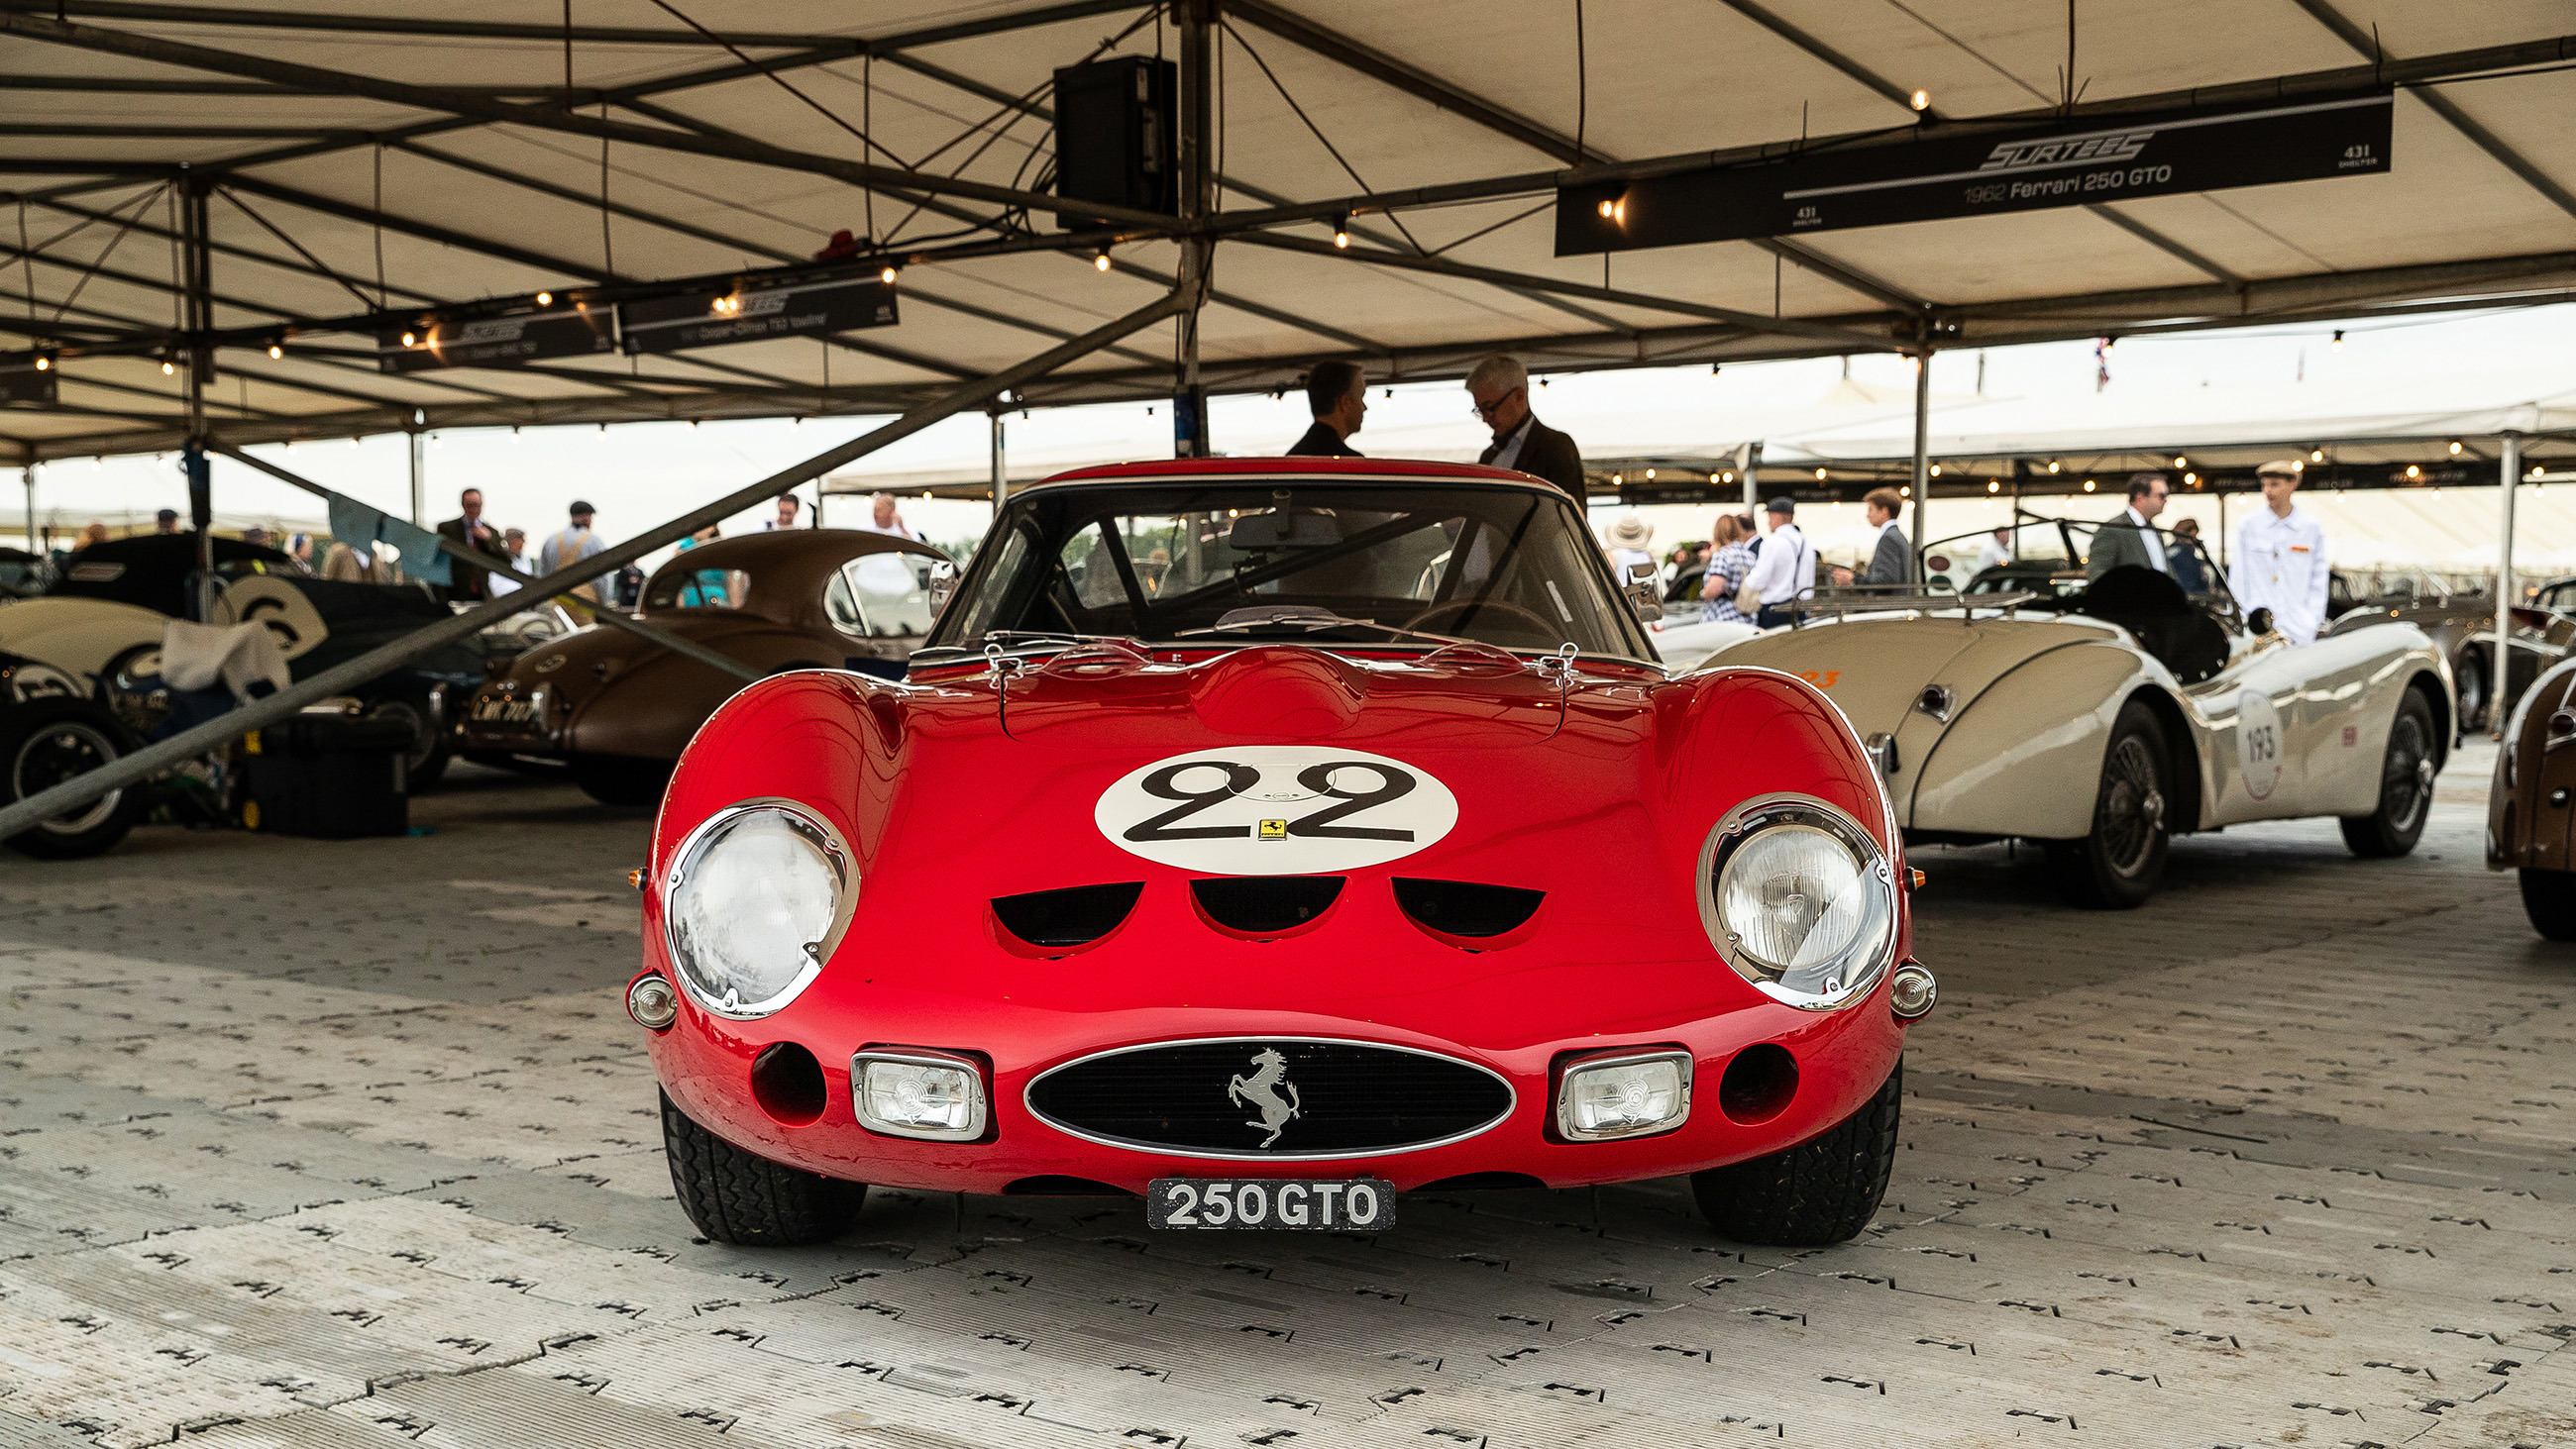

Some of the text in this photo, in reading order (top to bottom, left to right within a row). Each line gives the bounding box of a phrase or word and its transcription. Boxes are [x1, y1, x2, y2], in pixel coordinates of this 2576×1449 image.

[1979, 131, 2156, 172] SURTEES
[2344, 144, 2370, 158] 431
[1964, 163, 2173, 204] 1962 Ferrari 250 GTO
[1796, 206, 1817, 218] 431
[1791, 670, 1842, 689] 93
[2246, 725, 2276, 764] 193
[1123, 761, 1417, 843] 22
[1166, 1184, 1378, 1225] 250 GTO
